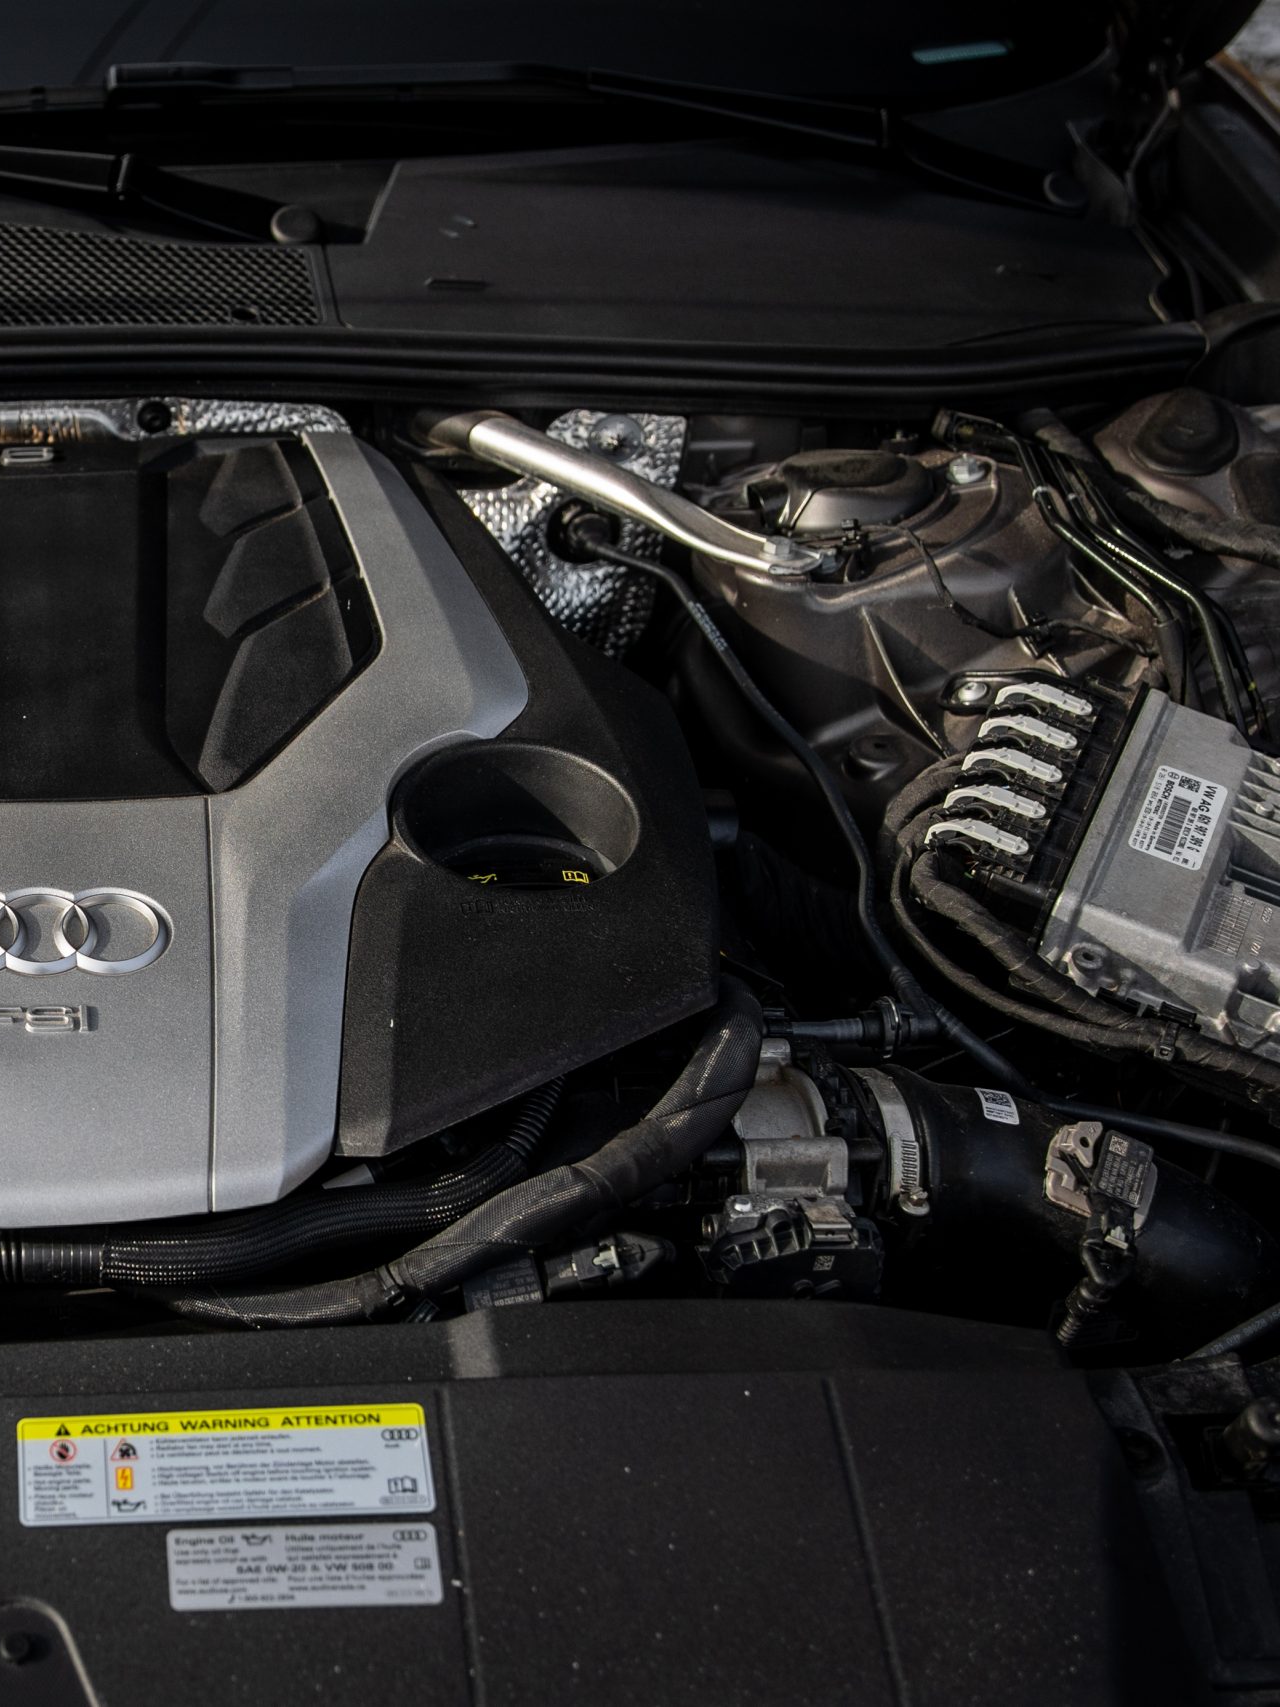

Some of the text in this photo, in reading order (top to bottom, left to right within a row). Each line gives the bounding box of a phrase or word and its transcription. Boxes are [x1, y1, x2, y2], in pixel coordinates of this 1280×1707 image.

[1160, 779, 1175, 800] BOSCH
[1202, 783, 1217, 800] VW
[1197, 798, 1212, 813] AG
[80, 1412, 381, 1434] ACHTUNG WARNING ATTENTION
[173, 1535, 234, 1546] Engine Oil
[284, 1531, 363, 1541] Huile moteur
[235, 1564, 261, 1574] SAE
[323, 1561, 347, 1571] VW
